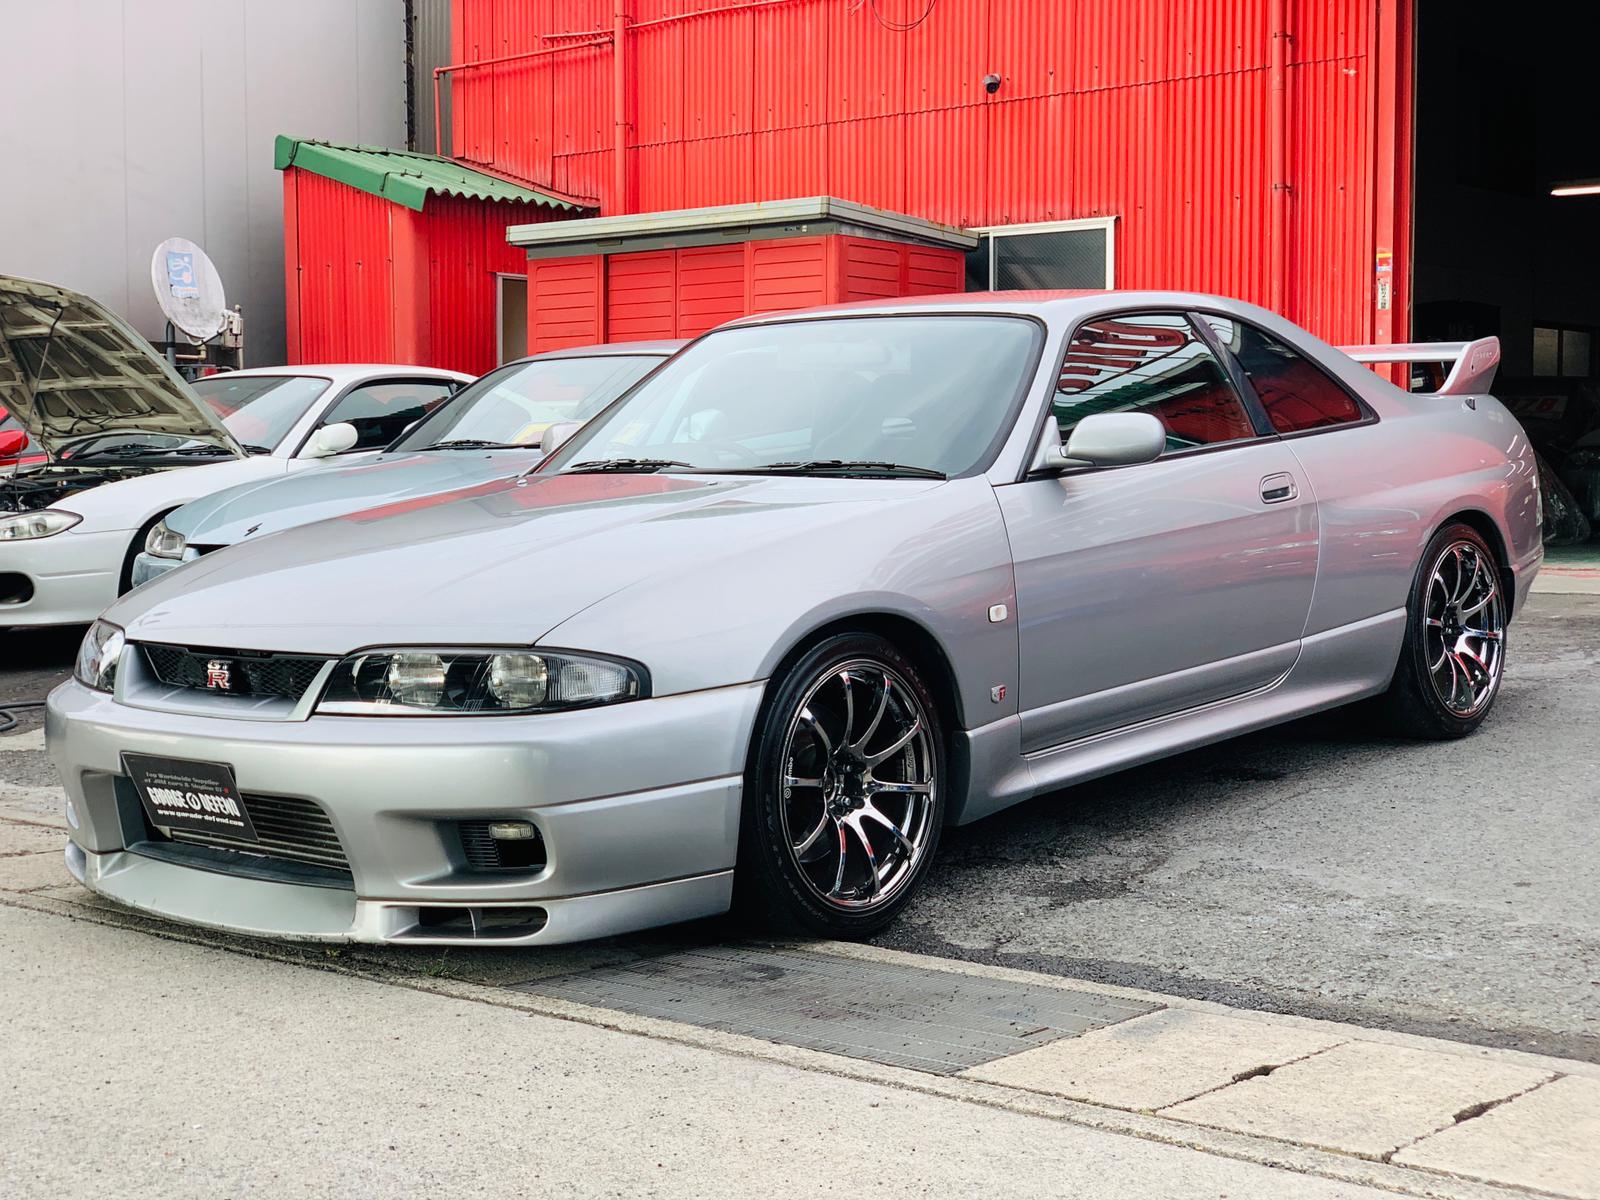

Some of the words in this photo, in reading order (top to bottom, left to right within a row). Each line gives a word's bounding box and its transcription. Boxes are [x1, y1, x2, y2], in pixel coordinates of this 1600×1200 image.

[207, 660, 232, 670] GT
[207, 669, 230, 689] R
[146, 786, 189, 809] GARAGE
[197, 792, 241, 817] DEFEND
